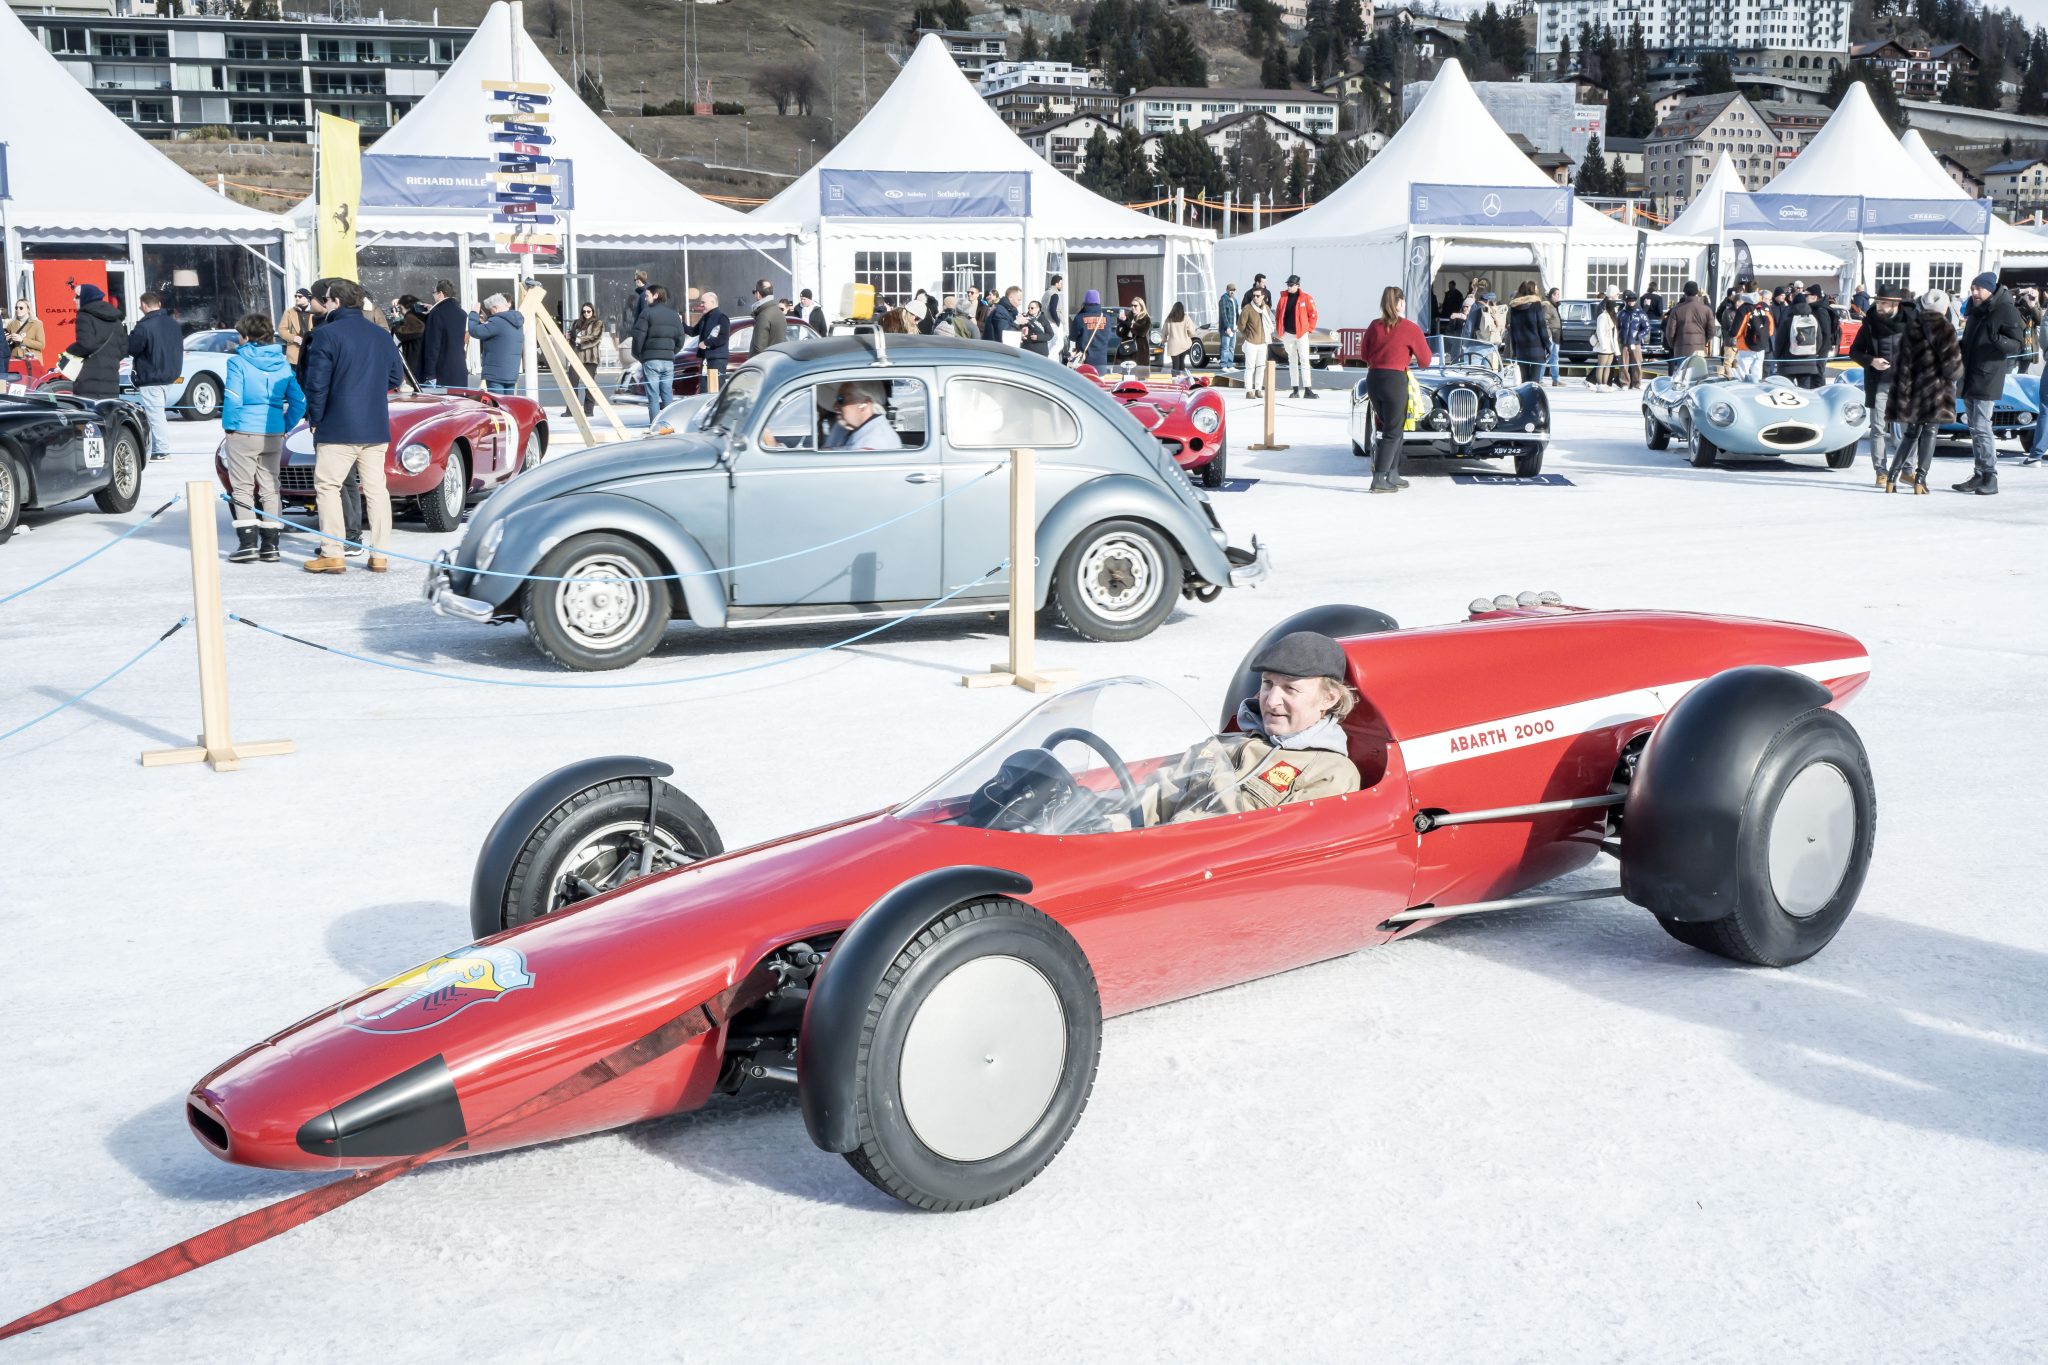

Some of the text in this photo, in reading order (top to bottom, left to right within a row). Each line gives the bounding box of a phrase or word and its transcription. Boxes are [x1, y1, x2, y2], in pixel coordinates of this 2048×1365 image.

[406, 176, 487, 187] RICHARD MILLE
[1769, 392, 1801, 406] 13
[88, 440, 101, 459] 254
[1450, 719, 1554, 753] ABARTH 2000
